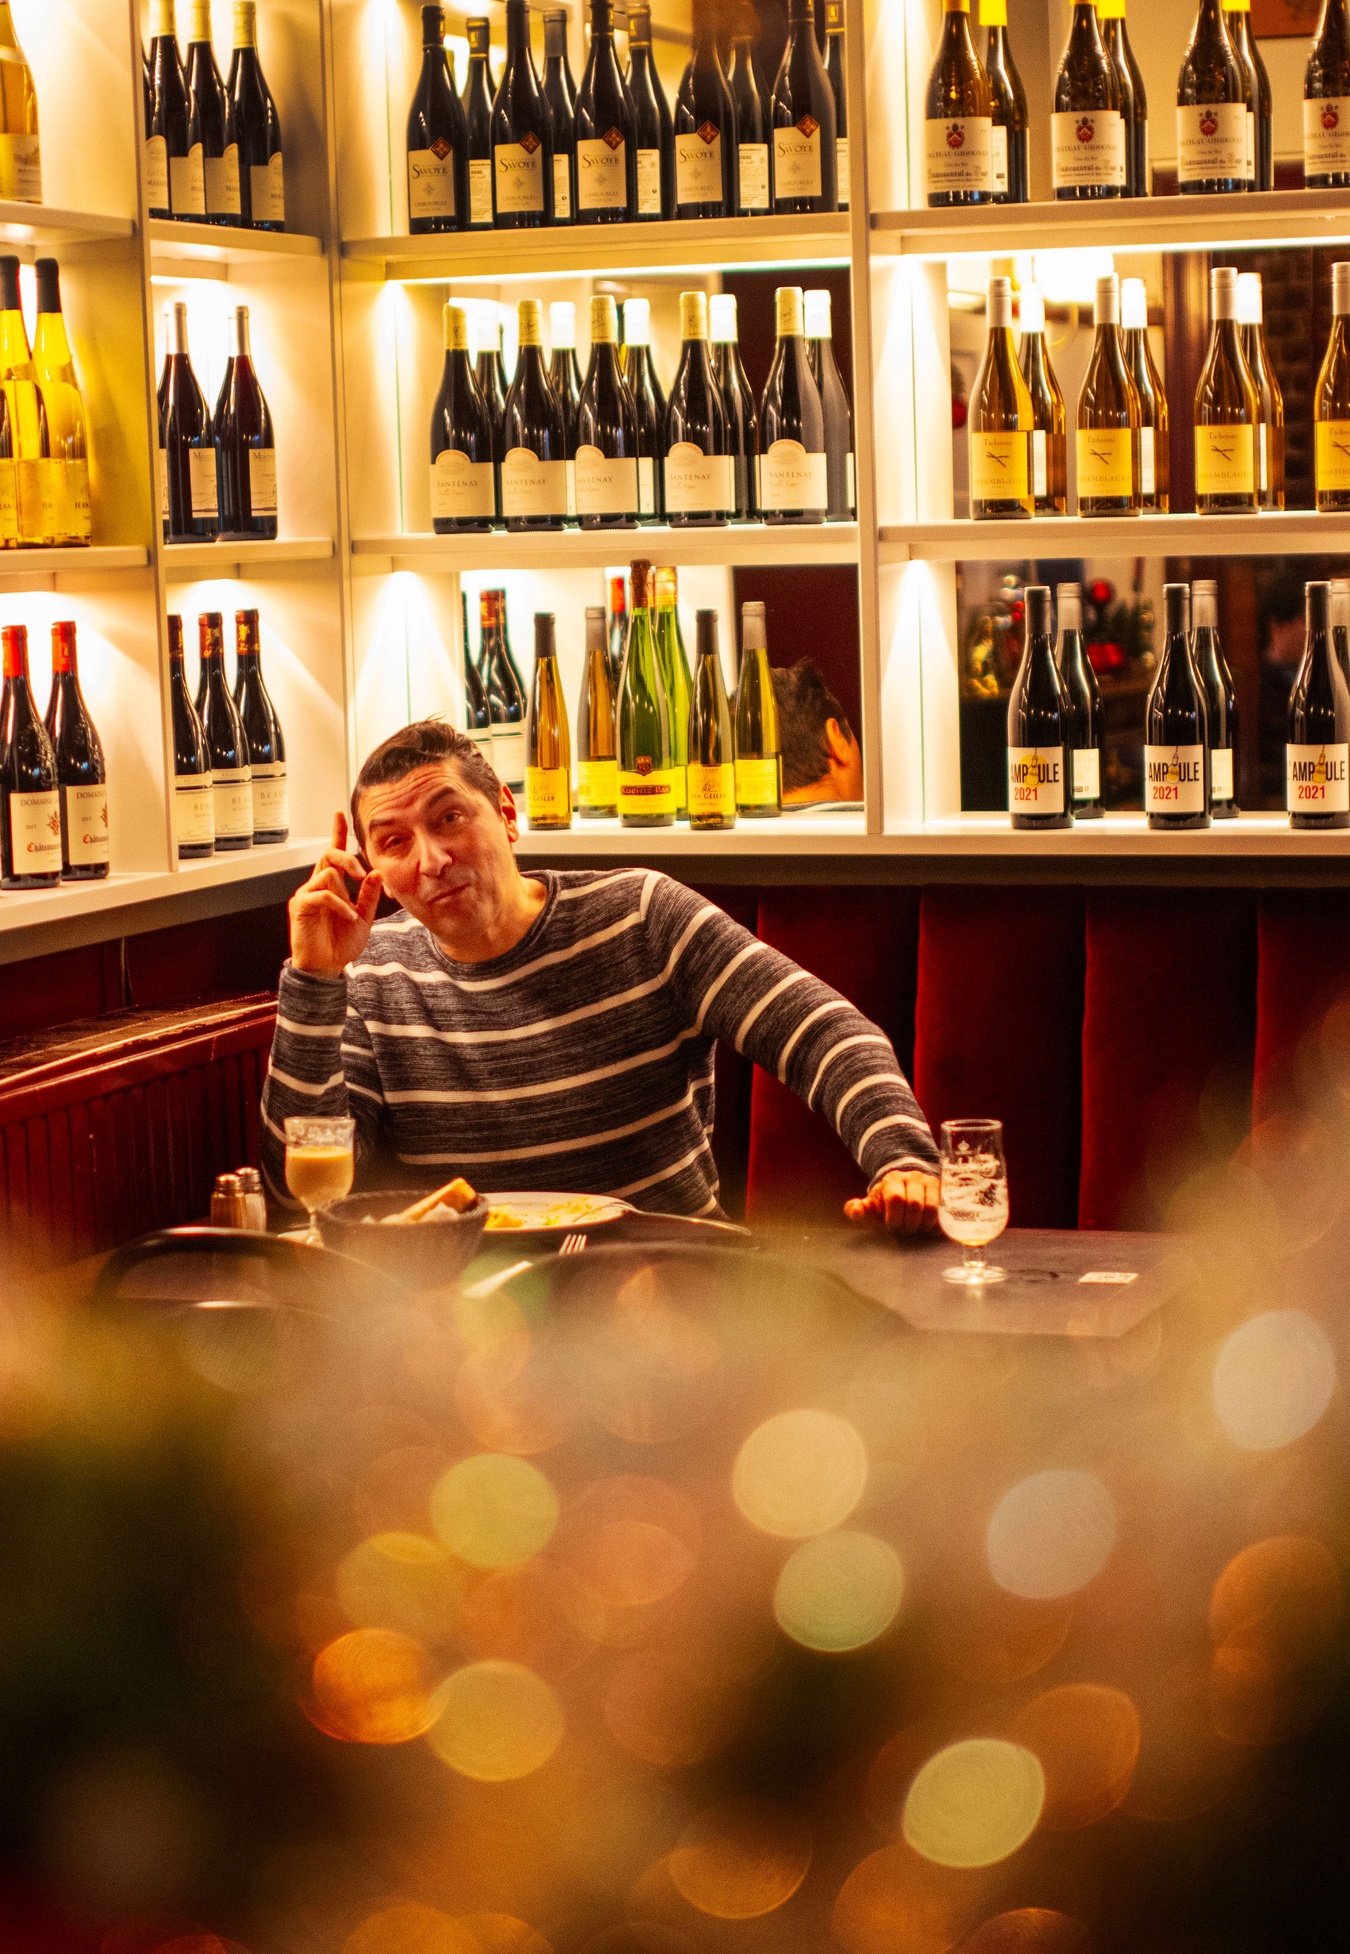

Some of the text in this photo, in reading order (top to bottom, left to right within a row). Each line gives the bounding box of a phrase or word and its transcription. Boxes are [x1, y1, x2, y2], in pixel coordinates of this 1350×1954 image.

[1014, 786, 1039, 801] 2021
[1153, 785, 1178, 800] 2021
[1298, 785, 1325, 799] 2021
